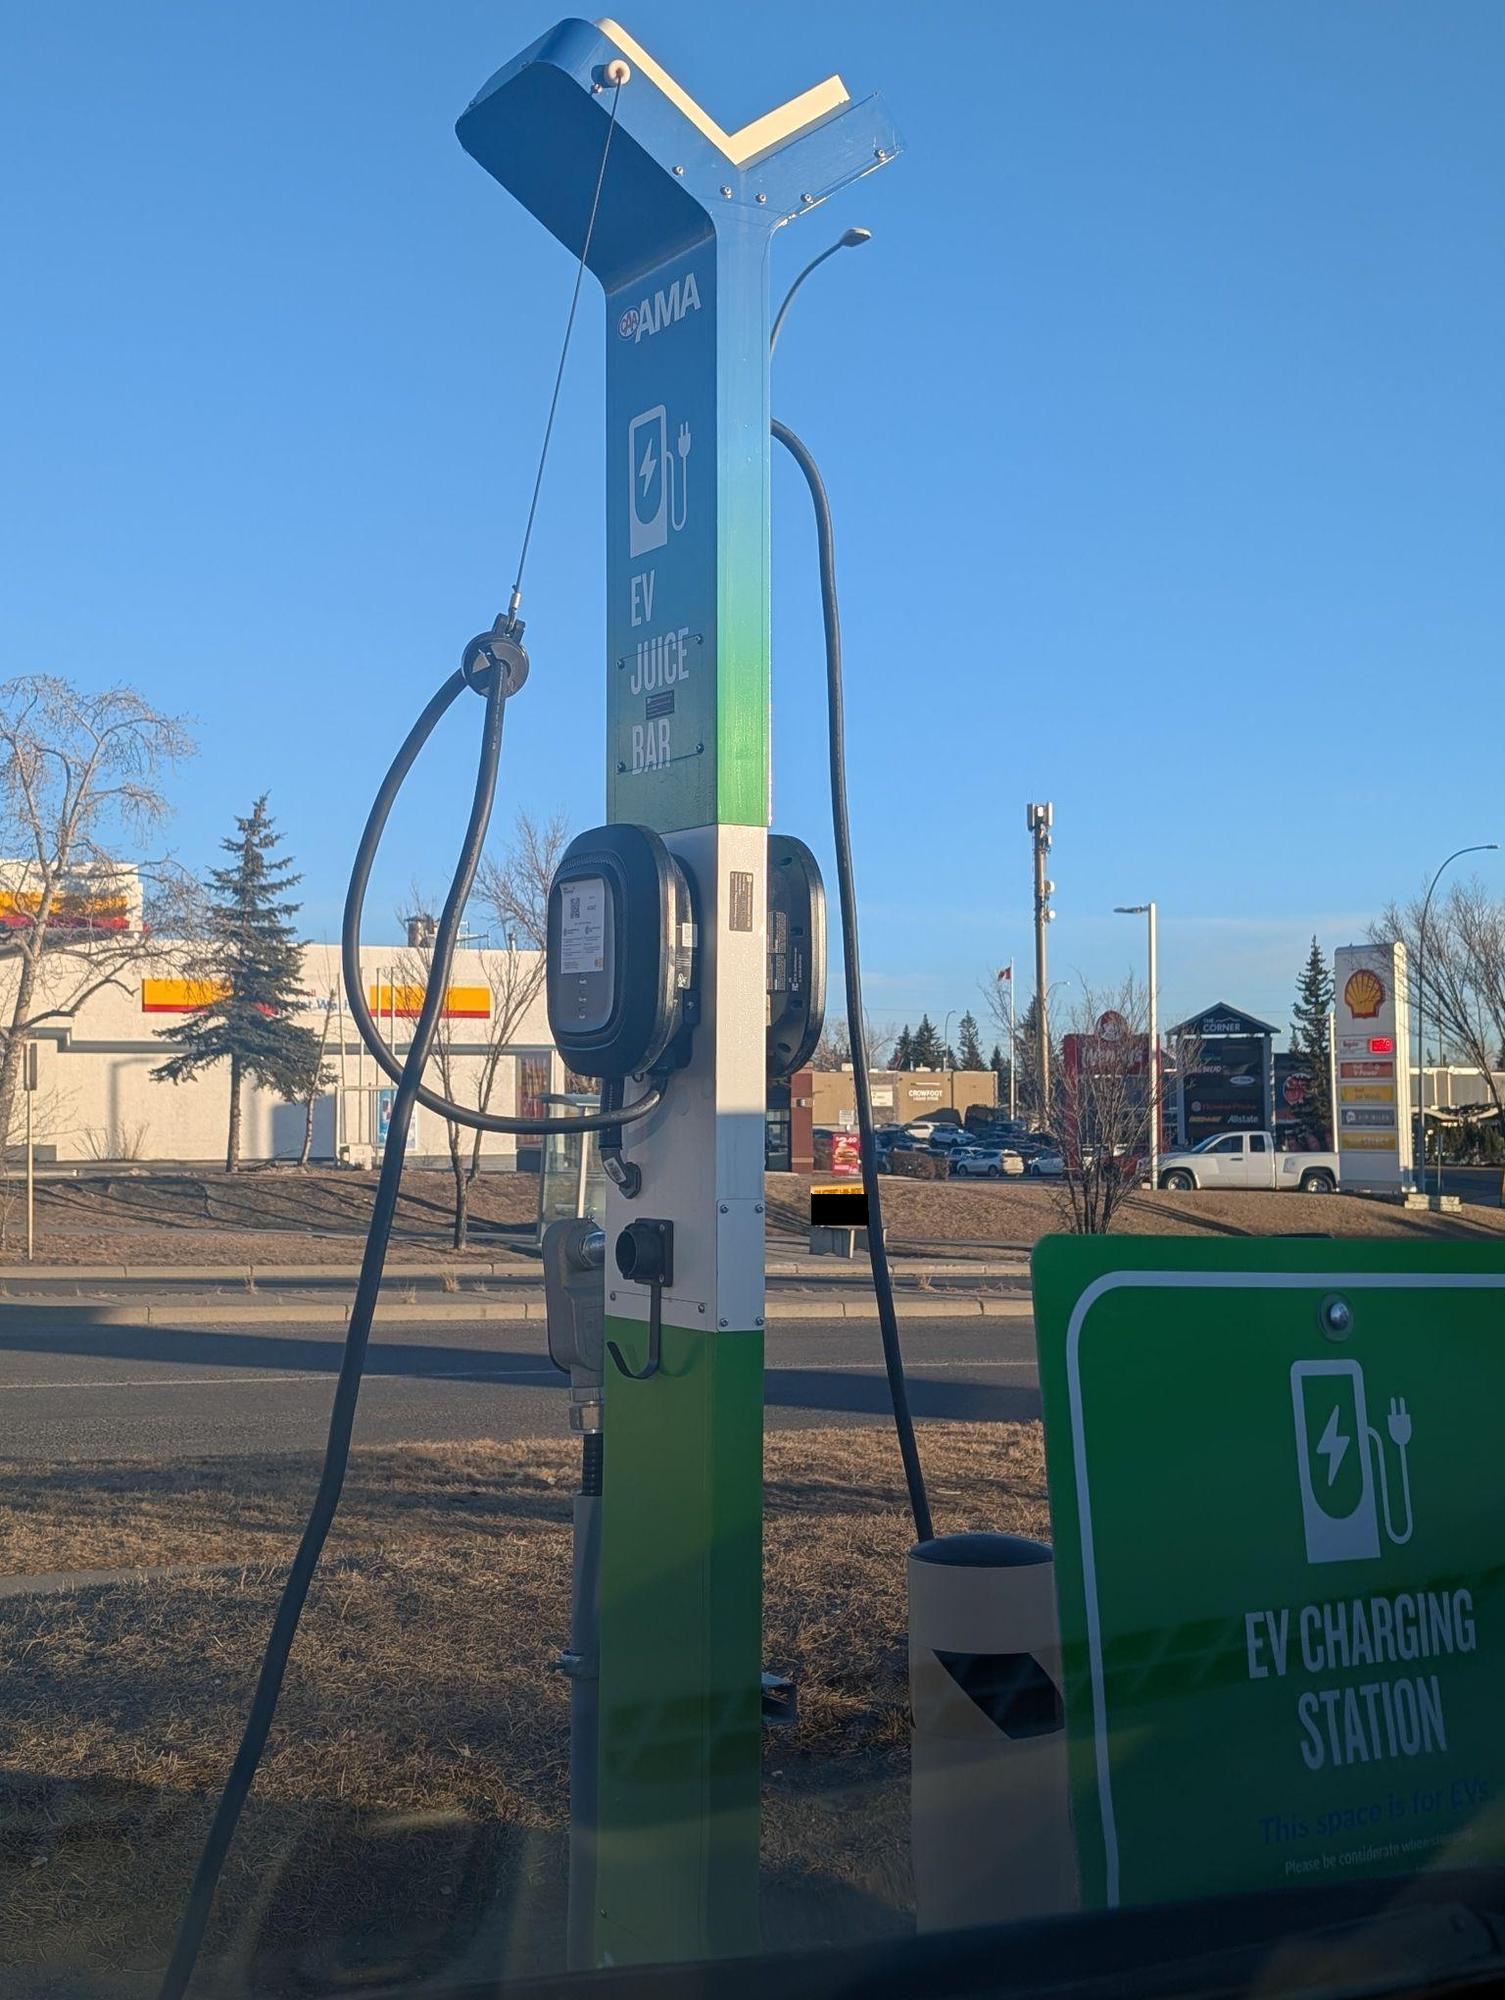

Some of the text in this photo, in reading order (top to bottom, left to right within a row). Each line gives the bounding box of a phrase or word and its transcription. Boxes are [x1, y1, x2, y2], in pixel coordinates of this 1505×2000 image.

[635, 273, 701, 344] AMA
[630, 570, 655, 627] EV
[630, 627, 689, 695] JUICE
[632, 718, 671, 775] BAR
[1203, 1023, 1241, 1033] CORNER
[908, 1089, 943, 1097] CROWFOOT
[1245, 1588, 1476, 1678] EV CHARGING
[1298, 1675, 1447, 1770] STATION
[1258, 1813, 1308, 1844] This
[1317, 1803, 1381, 1837] space
[1413, 1790, 1442, 1815] for
[1284, 1856, 1321, 1876] Please
